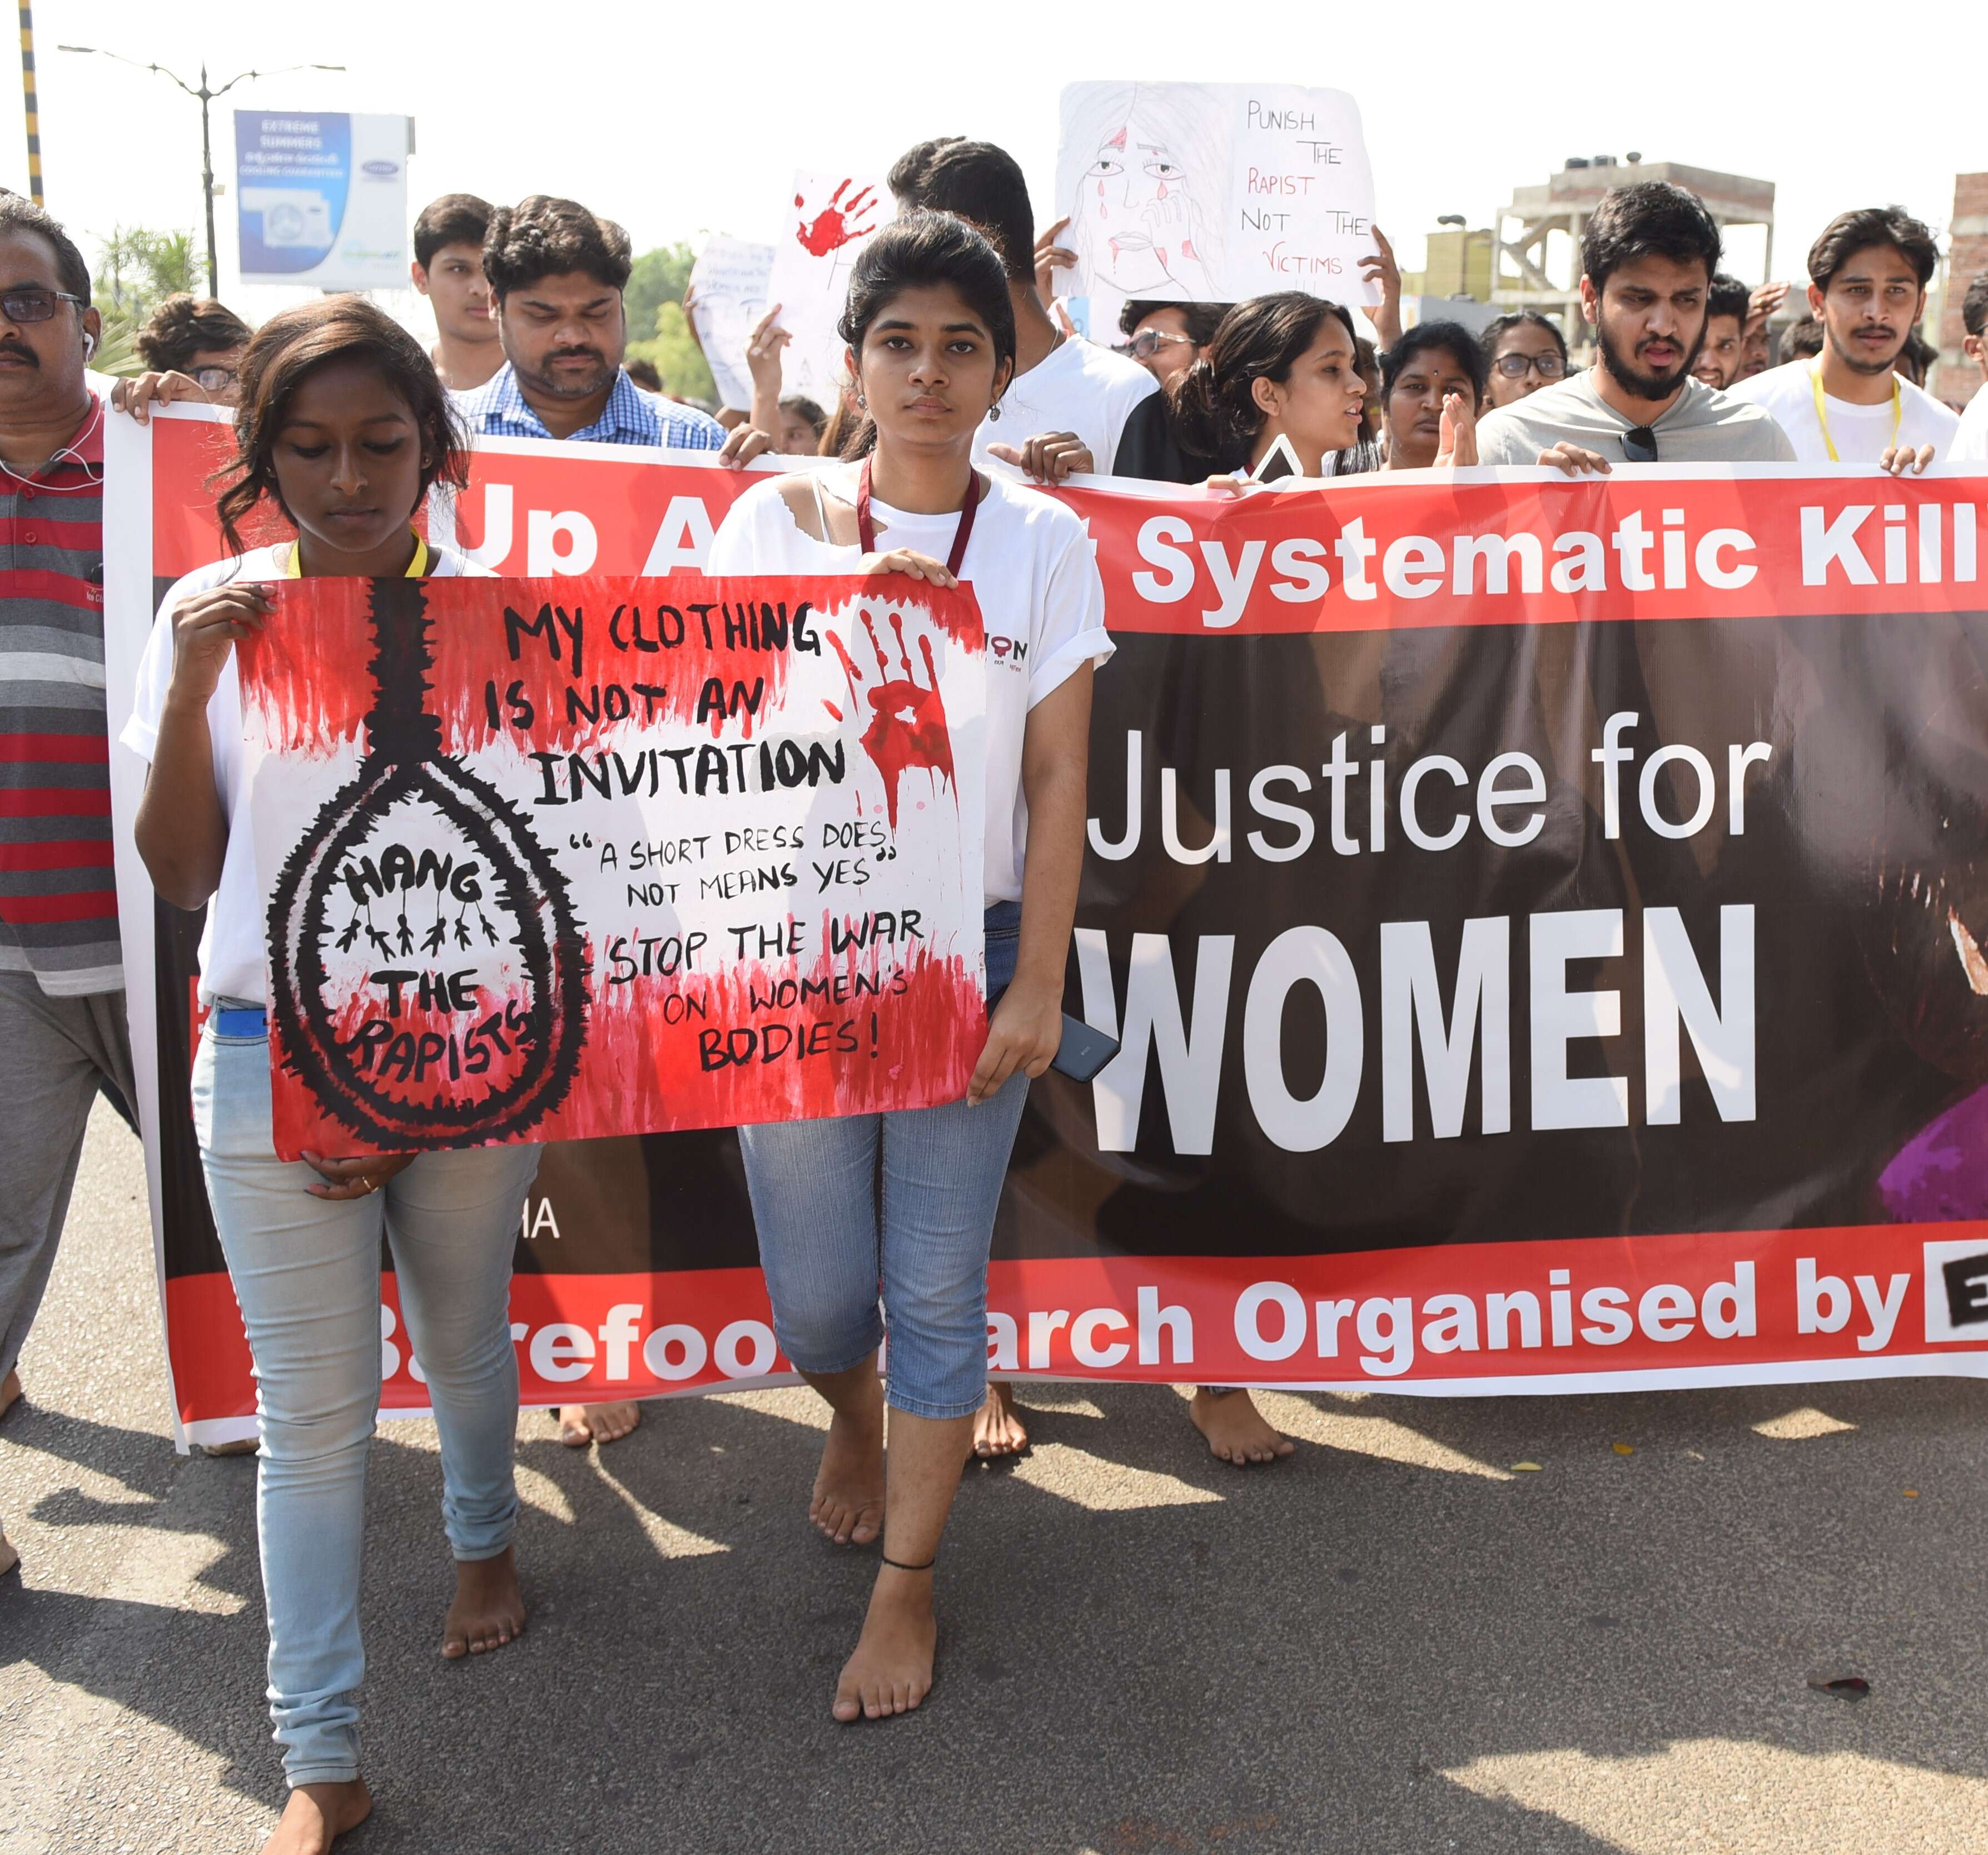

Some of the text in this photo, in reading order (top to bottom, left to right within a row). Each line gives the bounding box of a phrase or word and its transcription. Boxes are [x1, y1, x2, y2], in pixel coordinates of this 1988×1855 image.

[260, 135, 322, 150] SUMMERS
[261, 120, 320, 133] EXTREME
[1248, 100, 1315, 131] PUNISH
[1248, 167, 1315, 195] RAPIST
[1296, 141, 1344, 165] THE
[1241, 207, 1369, 236] NOT THE
[1263, 241, 1343, 275] VICTIMS
[427, 480, 598, 577] Up
[1131, 508, 1758, 628] Systematic
[1800, 502, 1988, 586] Kill
[504, 601, 822, 678] MY CLOTHING
[485, 676, 764, 731] IS NOT AN
[528, 739, 846, 806] INVITATION
[1087, 711, 1772, 866] Justice for
[343, 843, 483, 906] HANG
[629, 835, 712, 871] SHORT
[724, 825, 804, 855] DRESS
[823, 820, 887, 850] DOES
[627, 883, 682, 908] NOT
[700, 861, 798, 901] MEANS
[609, 909, 925, 984] STOP THE WAR
[369, 969, 479, 1018] THE
[663, 964, 908, 1026] ON WOMEN'S
[339, 999, 538, 1083] RAPISTS
[698, 1011, 879, 1072] BODIES!
[1073, 904, 1757, 1155] WOMEN
[986, 1286, 1194, 1370] arch
[1234, 1261, 1757, 1377] Organised
[1796, 1257, 1911, 1352] by
